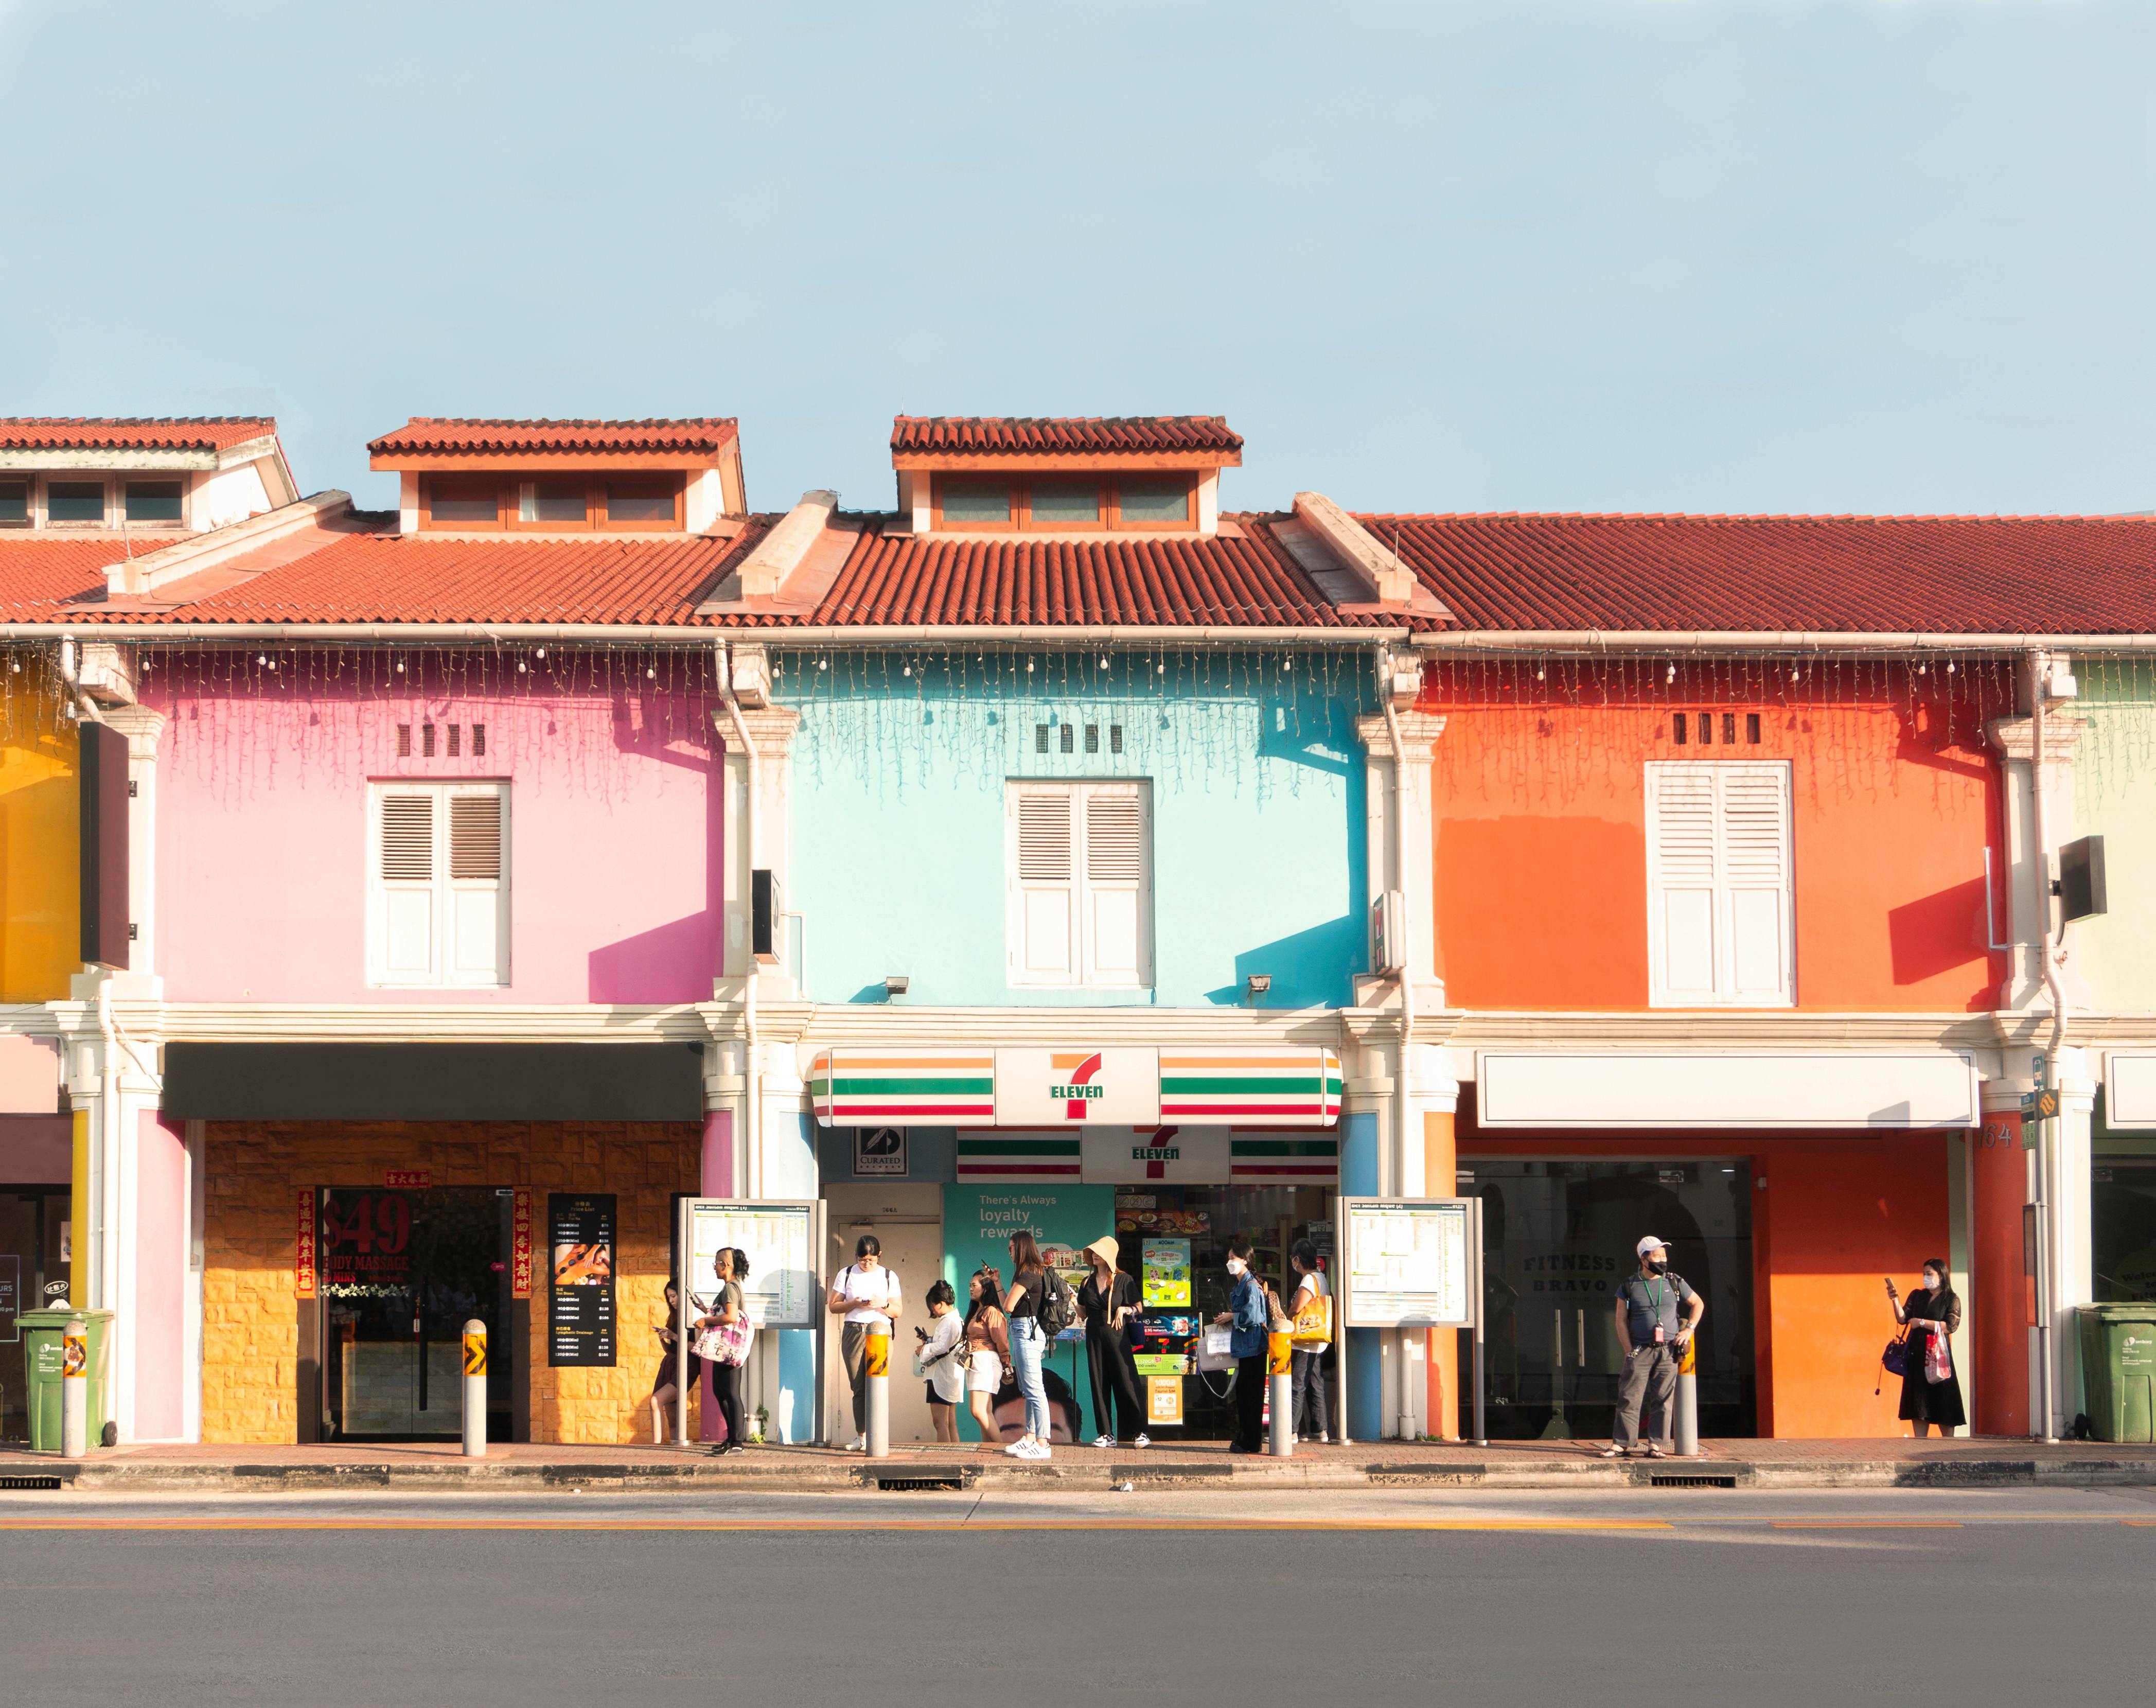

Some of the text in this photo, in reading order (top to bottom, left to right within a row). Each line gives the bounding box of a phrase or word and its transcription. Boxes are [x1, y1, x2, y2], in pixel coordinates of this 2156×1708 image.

[1052, 1052, 1101, 1119] 7
[980, 1195, 1057, 1207] There's Always
[980, 1208, 1030, 1224] loyalty
[324, 1194, 410, 1254] $49
[323, 1256, 409, 1271] BODY MASSAGE
[1524, 1254, 1615, 1271] FITNESS
[333, 1272, 356, 1282] MINS
[1533, 1280, 1607, 1291] BRAVO
